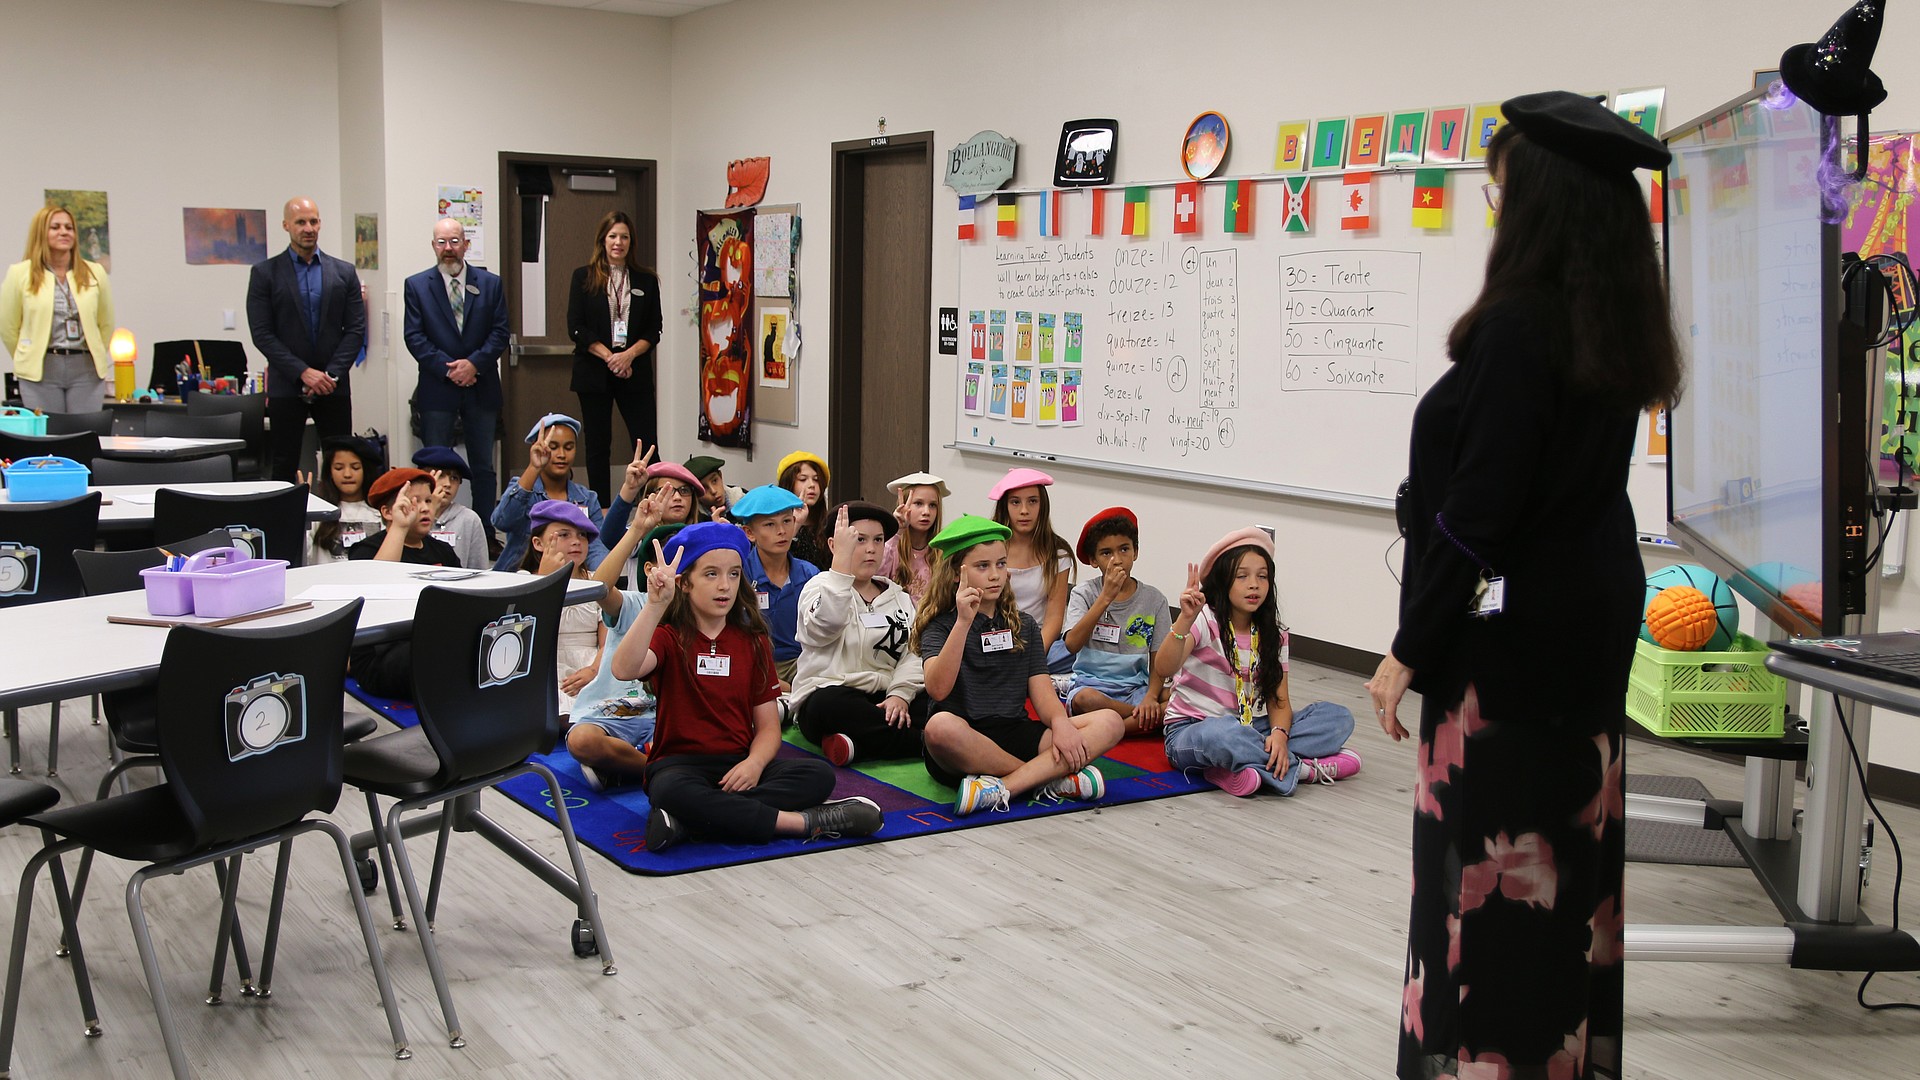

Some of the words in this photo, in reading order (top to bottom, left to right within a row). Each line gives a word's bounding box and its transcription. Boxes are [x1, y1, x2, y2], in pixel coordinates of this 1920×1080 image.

[950, 140, 1014, 176] BOULANGERIE
[995, 245, 1025, 265] Learning
[1057, 242, 1094, 263] Students
[997, 269, 1011, 283] will
[1015, 269, 1032, 281] learn
[1034, 267, 1050, 287] body
[1051, 267, 1071, 286] parts
[1163, 273, 1179, 290] 12
[1205, 270, 1224, 290] deux
[1228, 277, 1234, 287] 2
[1286, 266, 1308, 287] 30
[1324, 260, 1371, 286] Trente
[1006, 285, 1025, 299] create
[1203, 291, 1223, 307] trois
[1231, 295, 1236, 304] 3
[1161, 301, 1174, 318] 13
[1231, 308, 1236, 320] 4
[1285, 297, 1305, 319] 40
[1320, 294, 1375, 318] Quarante
[973, 329, 985, 349] 11
[989, 332, 1003, 350] 12
[1018, 331, 1032, 350] 13
[1039, 333, 1053, 352] 14
[1067, 329, 1082, 348] 15
[1165, 328, 1176, 350] 14
[1284, 328, 1303, 348] 50
[1324, 328, 1384, 356] Cinquante
[1106, 359, 1136, 377] quinze
[1151, 357, 1162, 372] 15
[1230, 359, 1236, 370] 7
[1285, 360, 1301, 381] 60
[1326, 360, 1385, 385] Soixante
[966, 378, 977, 397] 16
[992, 384, 1006, 402] 17
[1013, 386, 1025, 404] 18
[1041, 387, 1056, 407] 19
[1061, 390, 1077, 408] 20
[1204, 381, 1225, 398] neuf
[1228, 384, 1235, 397] 9
[1228, 400, 1235, 408] 10
[0, 565, 13, 582] 5
[255, 710, 271, 731] 2
